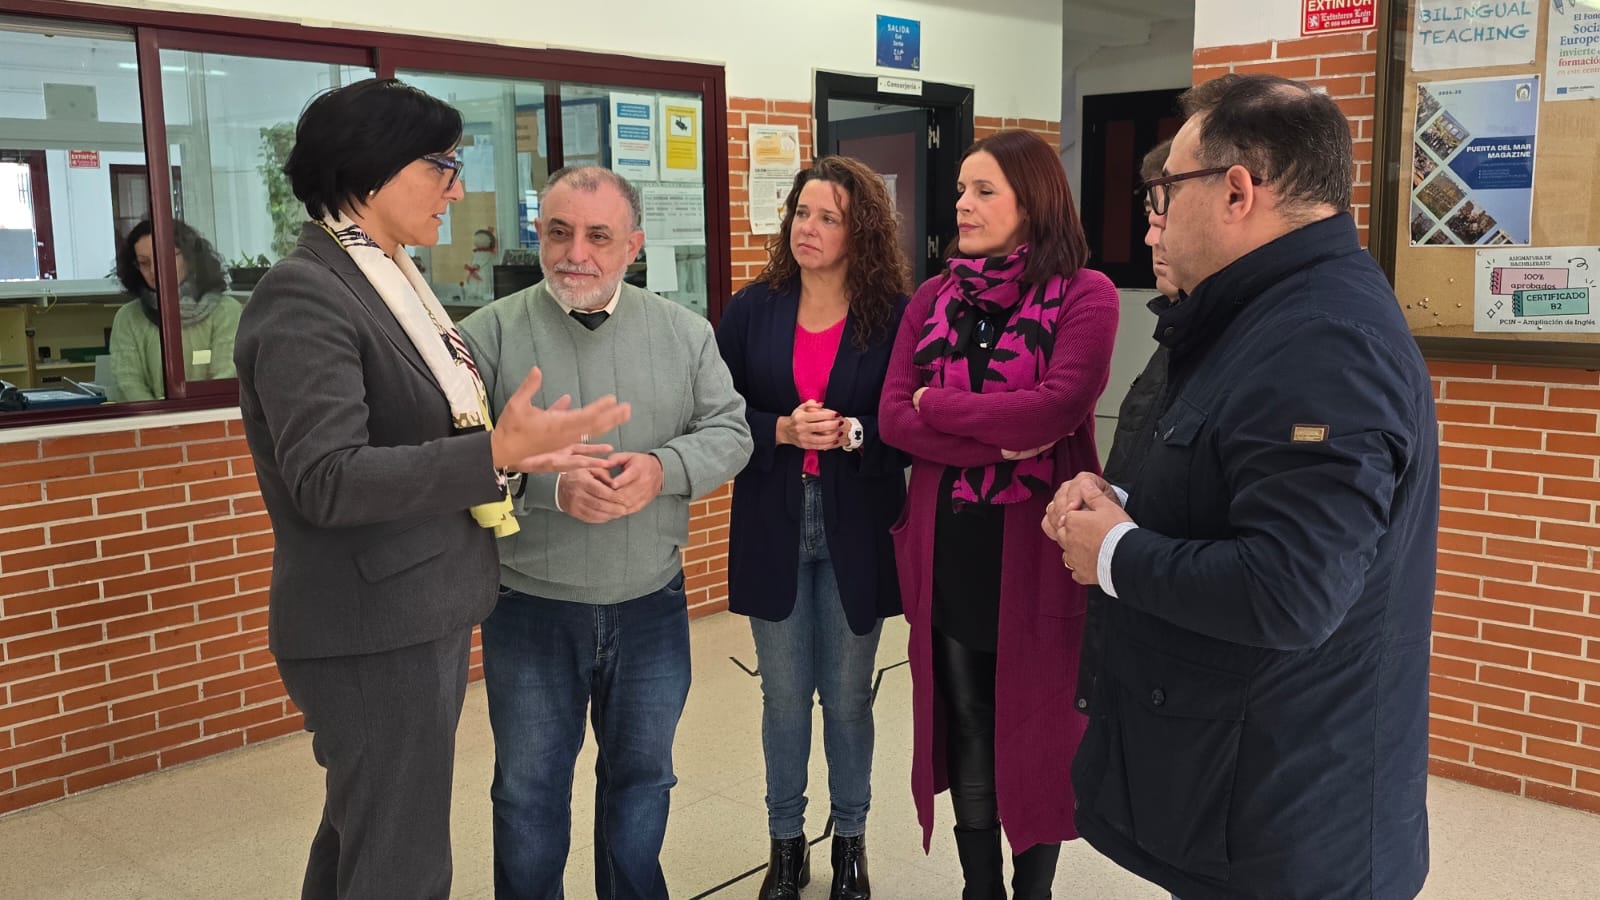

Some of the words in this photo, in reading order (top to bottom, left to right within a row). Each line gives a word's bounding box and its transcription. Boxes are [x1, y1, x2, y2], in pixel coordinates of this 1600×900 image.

[1421, 1, 1532, 23] BILINGUAL
[888, 24, 910, 34] SALIDA
[1419, 24, 1530, 45] TEACHING
[1559, 47, 1596, 57] invierte
[1558, 56, 1600, 67] formació
[1487, 151, 1531, 159] MAGAZINE
[1523, 273, 1545, 281] 100%
[1510, 282, 1556, 290] aprobados
[1526, 292, 1586, 302] CERTIFICADO
[1550, 302, 1562, 310] B2
[1574, 318, 1596, 327] Inglés
